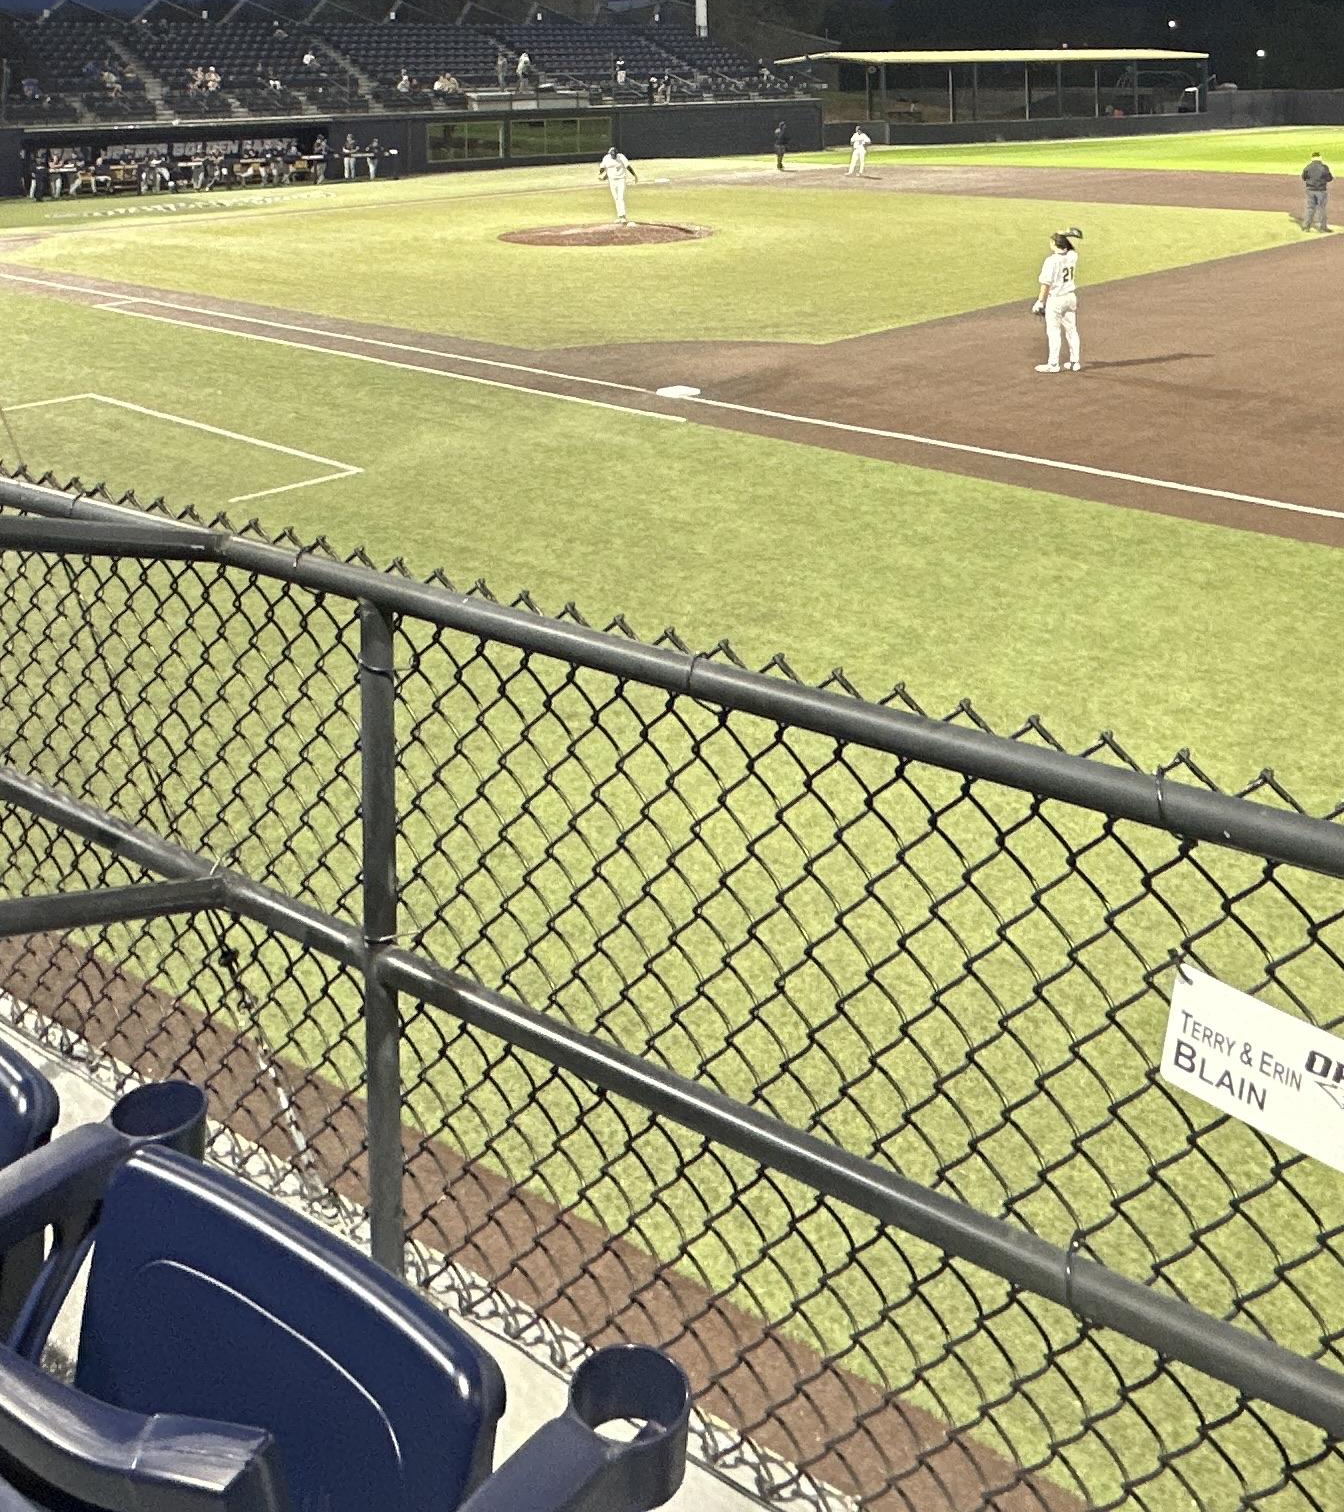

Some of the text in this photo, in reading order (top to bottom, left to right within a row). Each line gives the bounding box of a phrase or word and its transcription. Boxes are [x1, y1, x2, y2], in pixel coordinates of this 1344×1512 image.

[1062, 266, 1074, 283] 21
[1173, 1038, 1267, 1112] BLAIN
[1181, 1008, 1303, 1092] TERRY & ERIN
